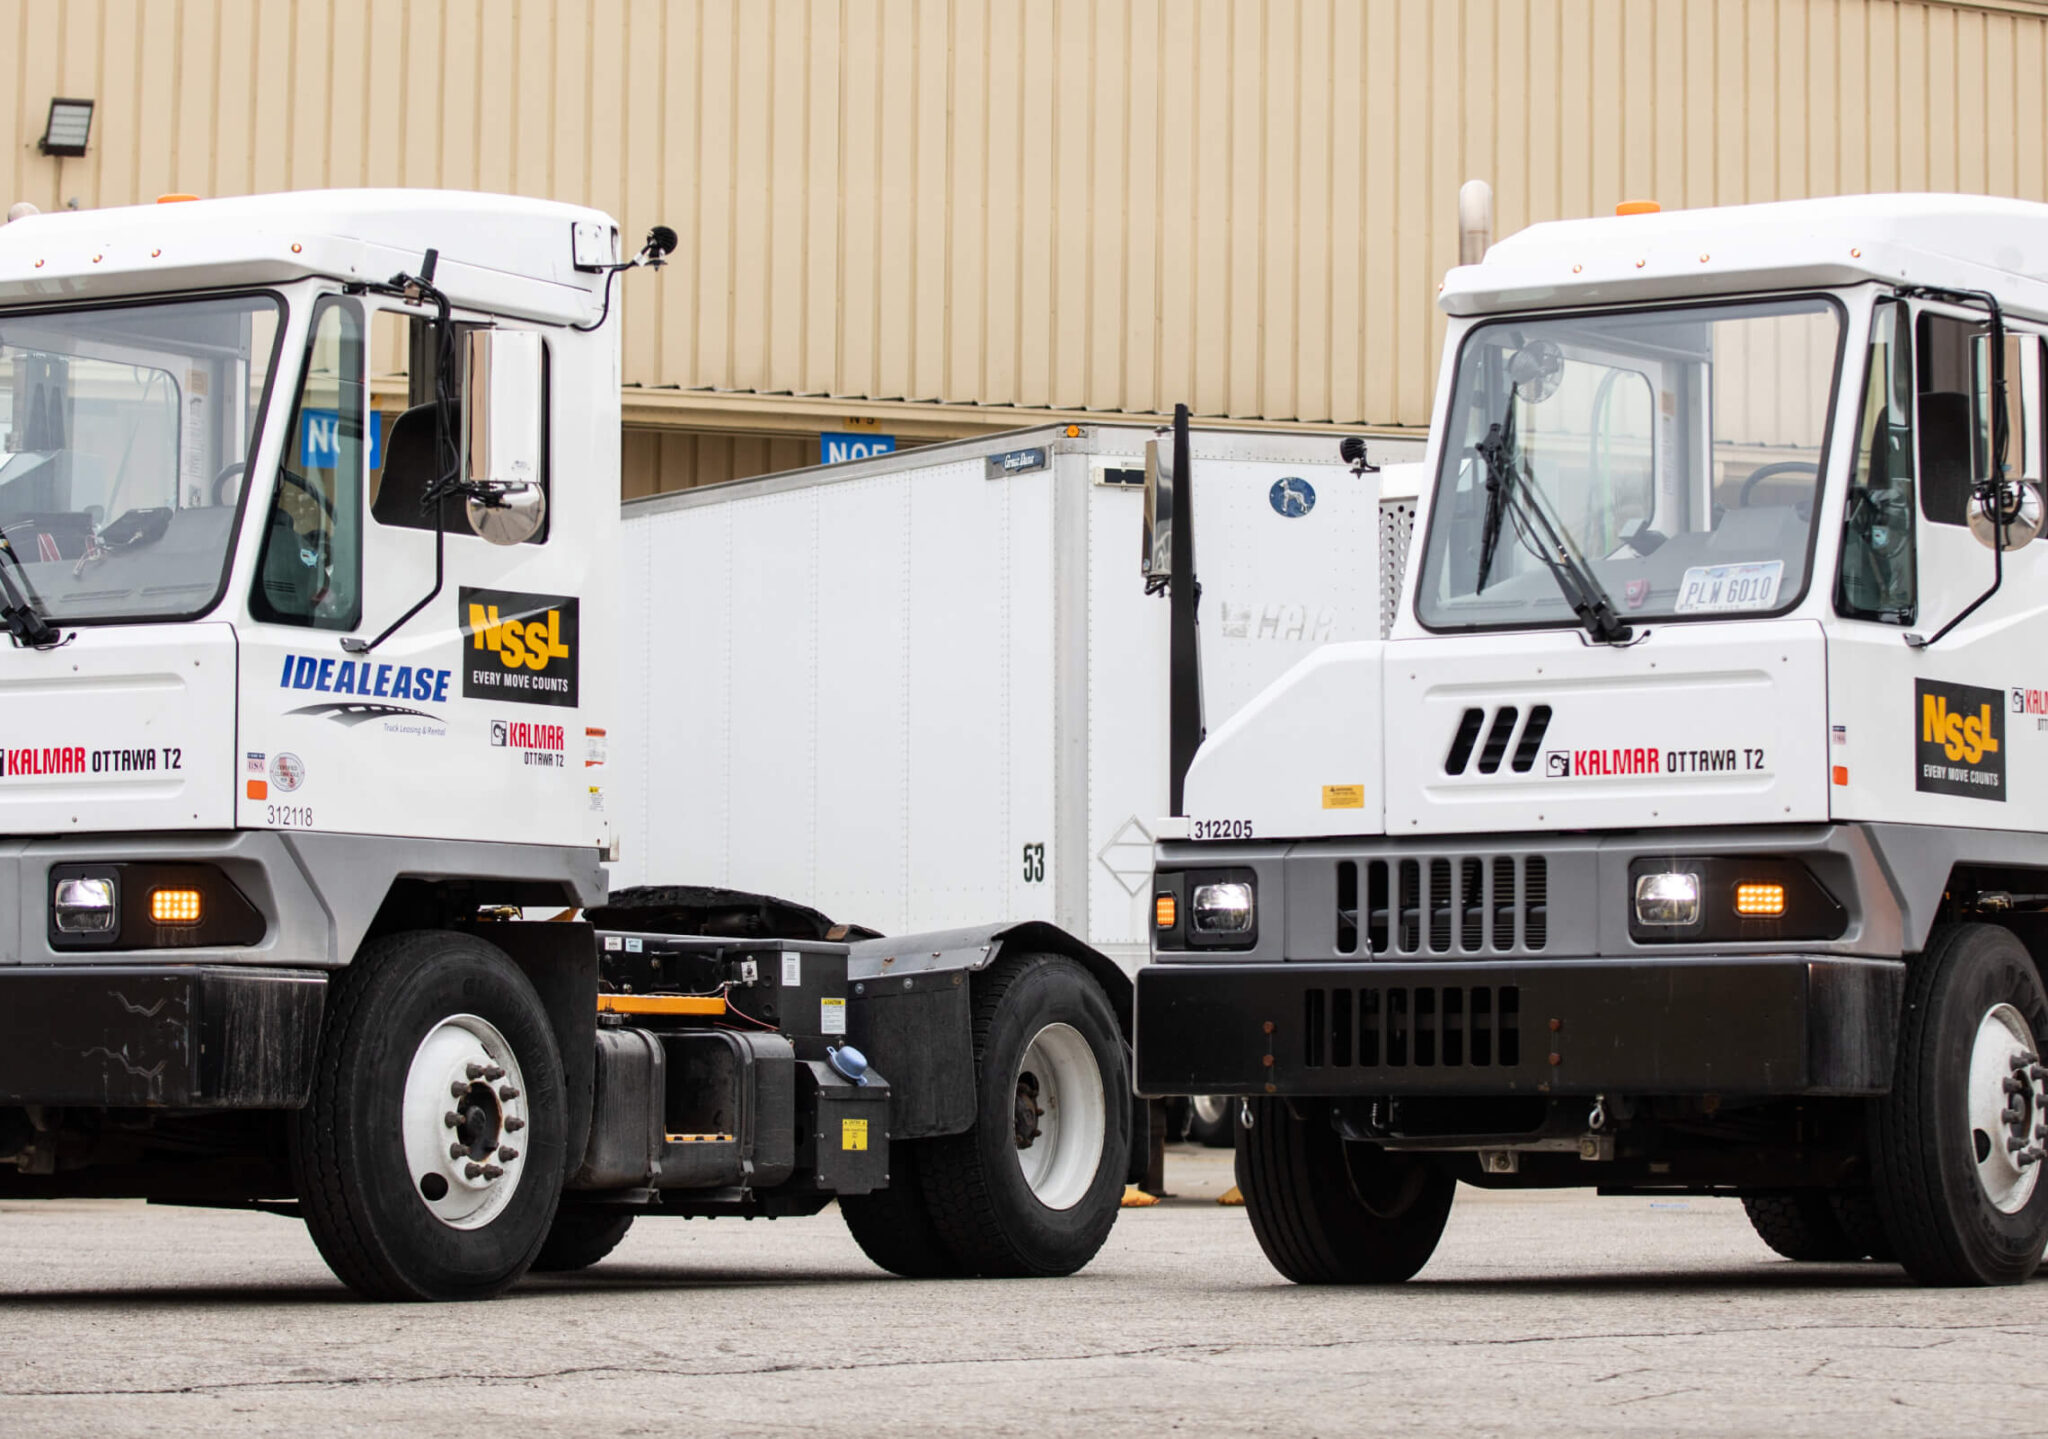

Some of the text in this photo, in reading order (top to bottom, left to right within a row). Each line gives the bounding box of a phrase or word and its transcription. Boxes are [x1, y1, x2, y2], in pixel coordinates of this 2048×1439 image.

[1727, 576, 1772, 603] 6010
[469, 603, 569, 671] NSSL
[280, 654, 452, 702] IDEALEASE
[473, 670, 569, 692] EVERY MOVE COUNTS
[384, 722, 399, 732] Truck
[400, 724, 422, 736] Leasing
[428, 726, 447, 737] Rental
[509, 722, 564, 750] KALMAR
[1923, 693, 1999, 764] NSSL
[8, 747, 182, 776] KALMAR OTTAWA T2
[524, 752, 564, 767] OTTAWA T2
[1574, 748, 1765, 776] KALMAR OTTAWA T2
[1923, 764, 1999, 787] EVERY MOVE COUNTS
[267, 804, 313, 827] 312118
[1194, 819, 1253, 839] 312205
[1023, 842, 1045, 883] 53
